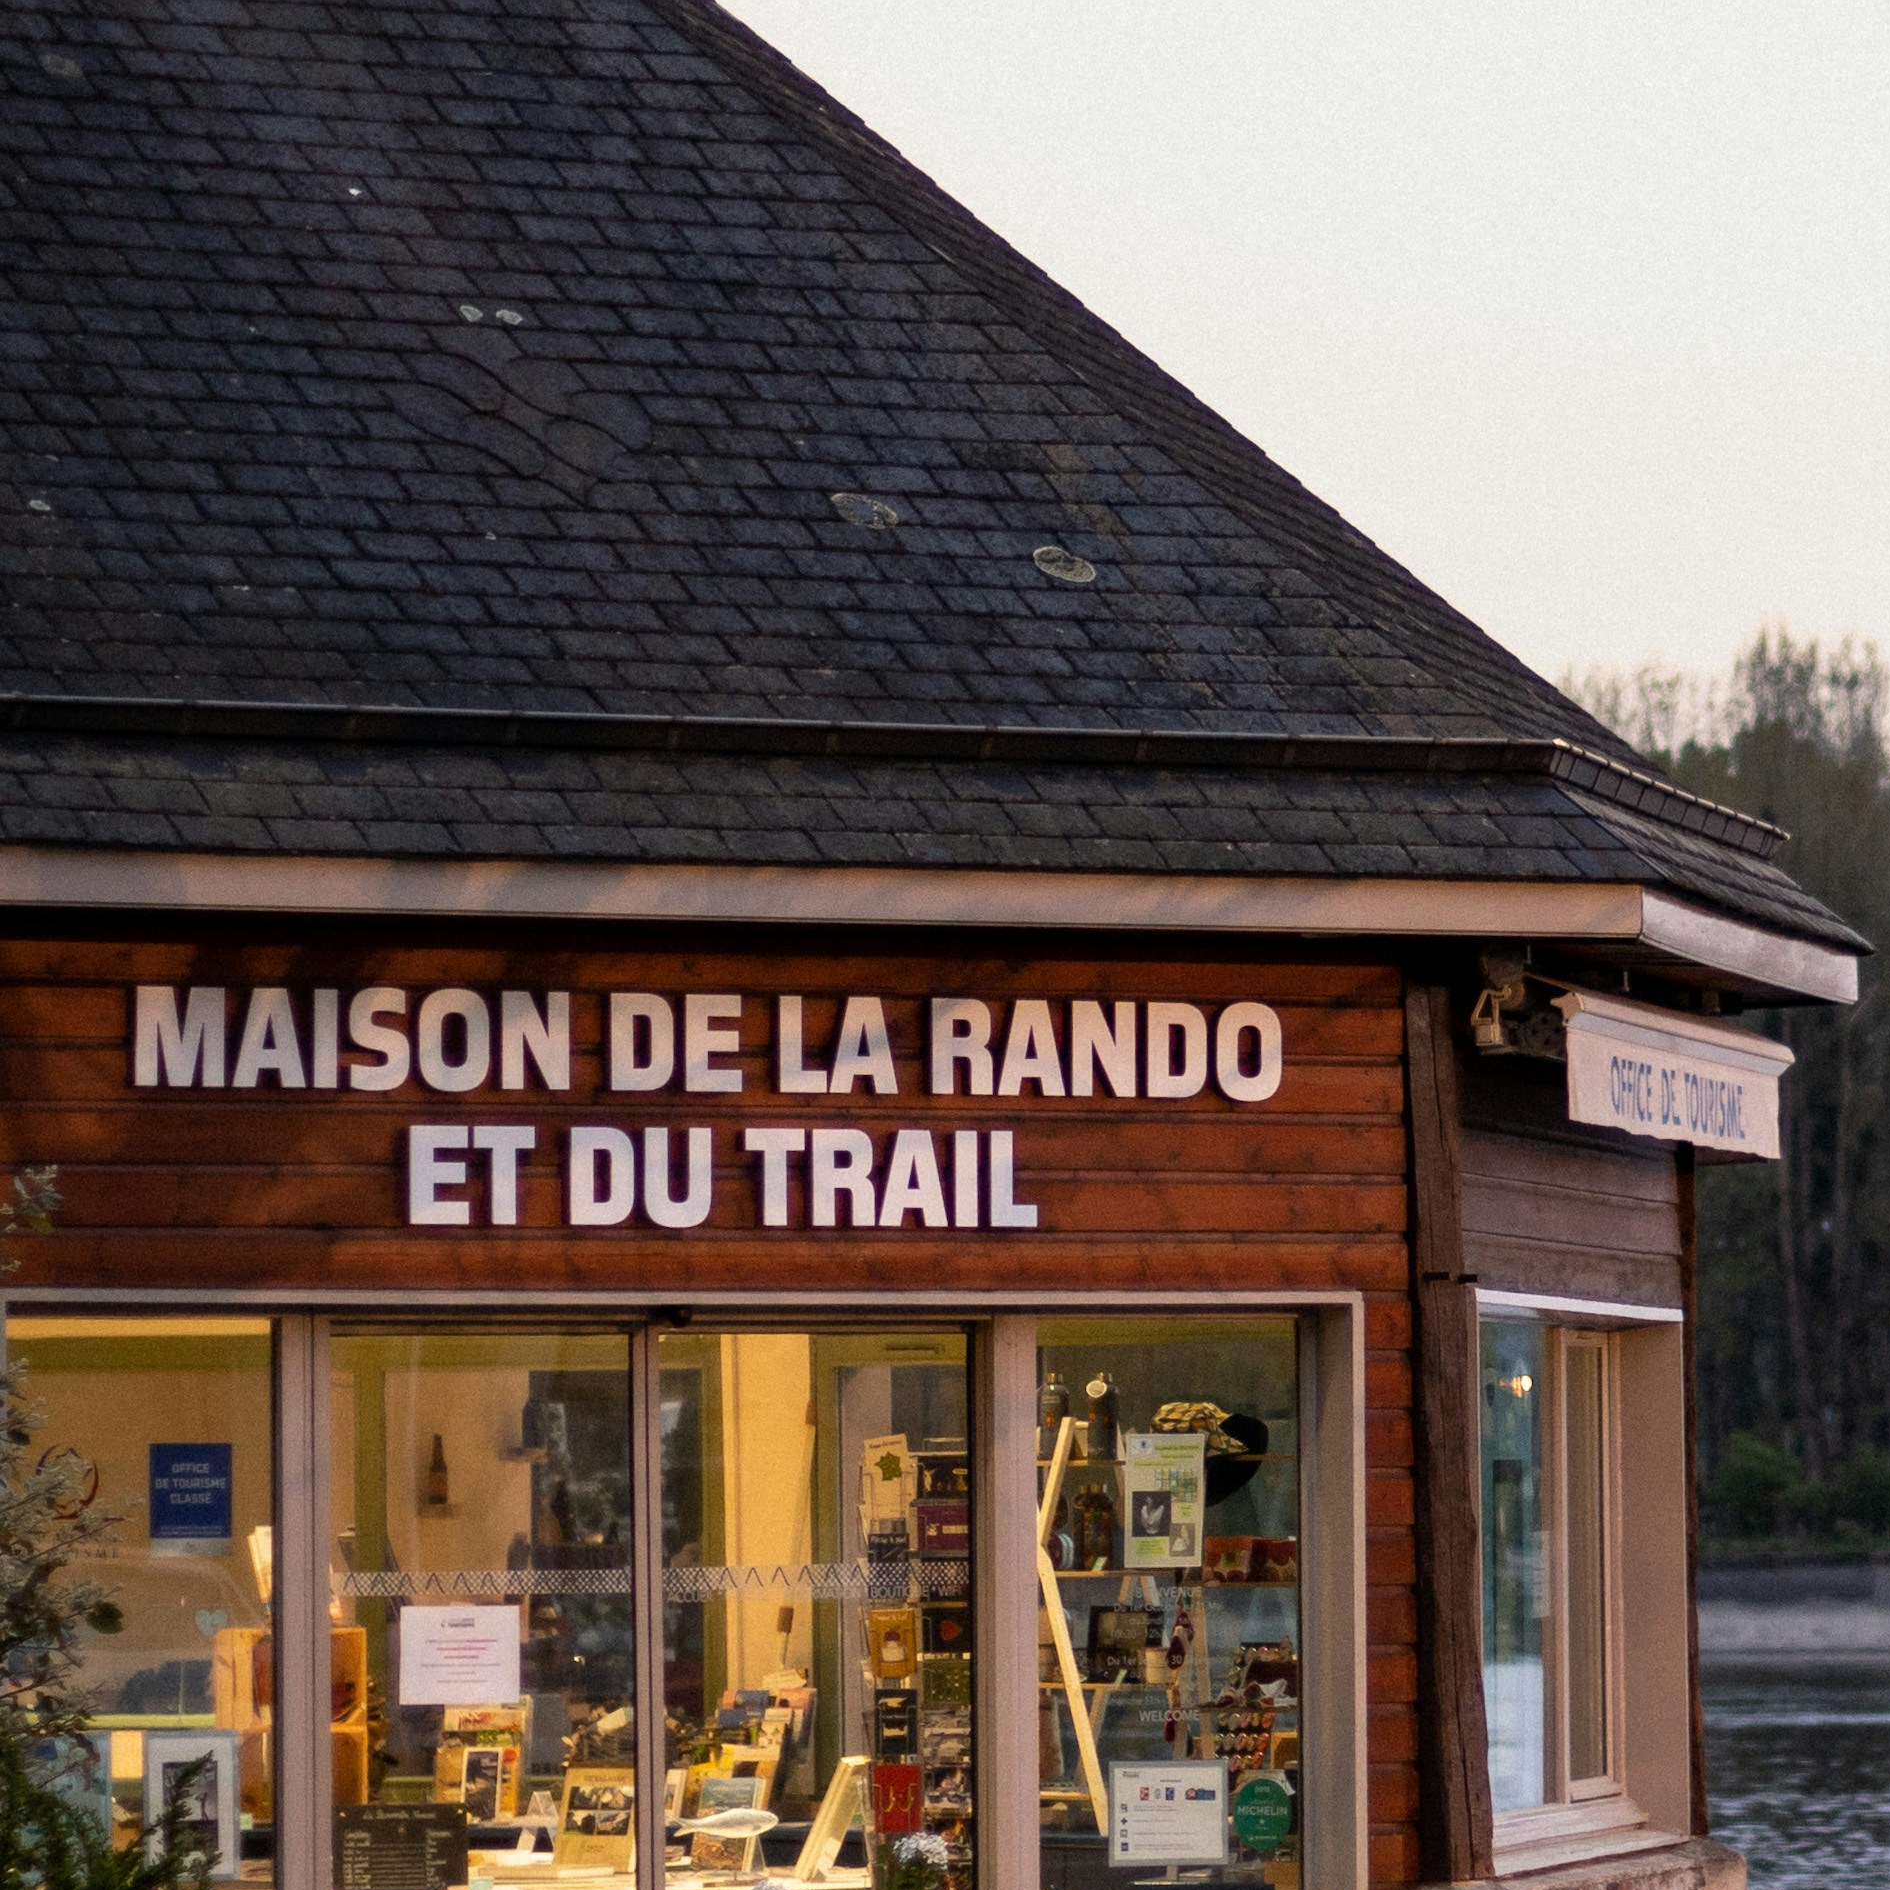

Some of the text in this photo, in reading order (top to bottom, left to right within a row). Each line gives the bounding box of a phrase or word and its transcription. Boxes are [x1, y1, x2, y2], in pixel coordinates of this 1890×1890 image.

[134, 985, 1284, 1104] MAISON DE LA RANDO
[1611, 1055, 1746, 1140] OFFICE DE TOURISME
[408, 1122, 1040, 1230] ET DU TRAIL
[171, 1462, 210, 1474] OFFICE
[155, 1476, 227, 1490] DE TOURISME
[870, 1585, 930, 1599] BOUTIQE
[1138, 1709, 1201, 1723] WELCOME
[1236, 1805, 1289, 1817] MICHELIN
